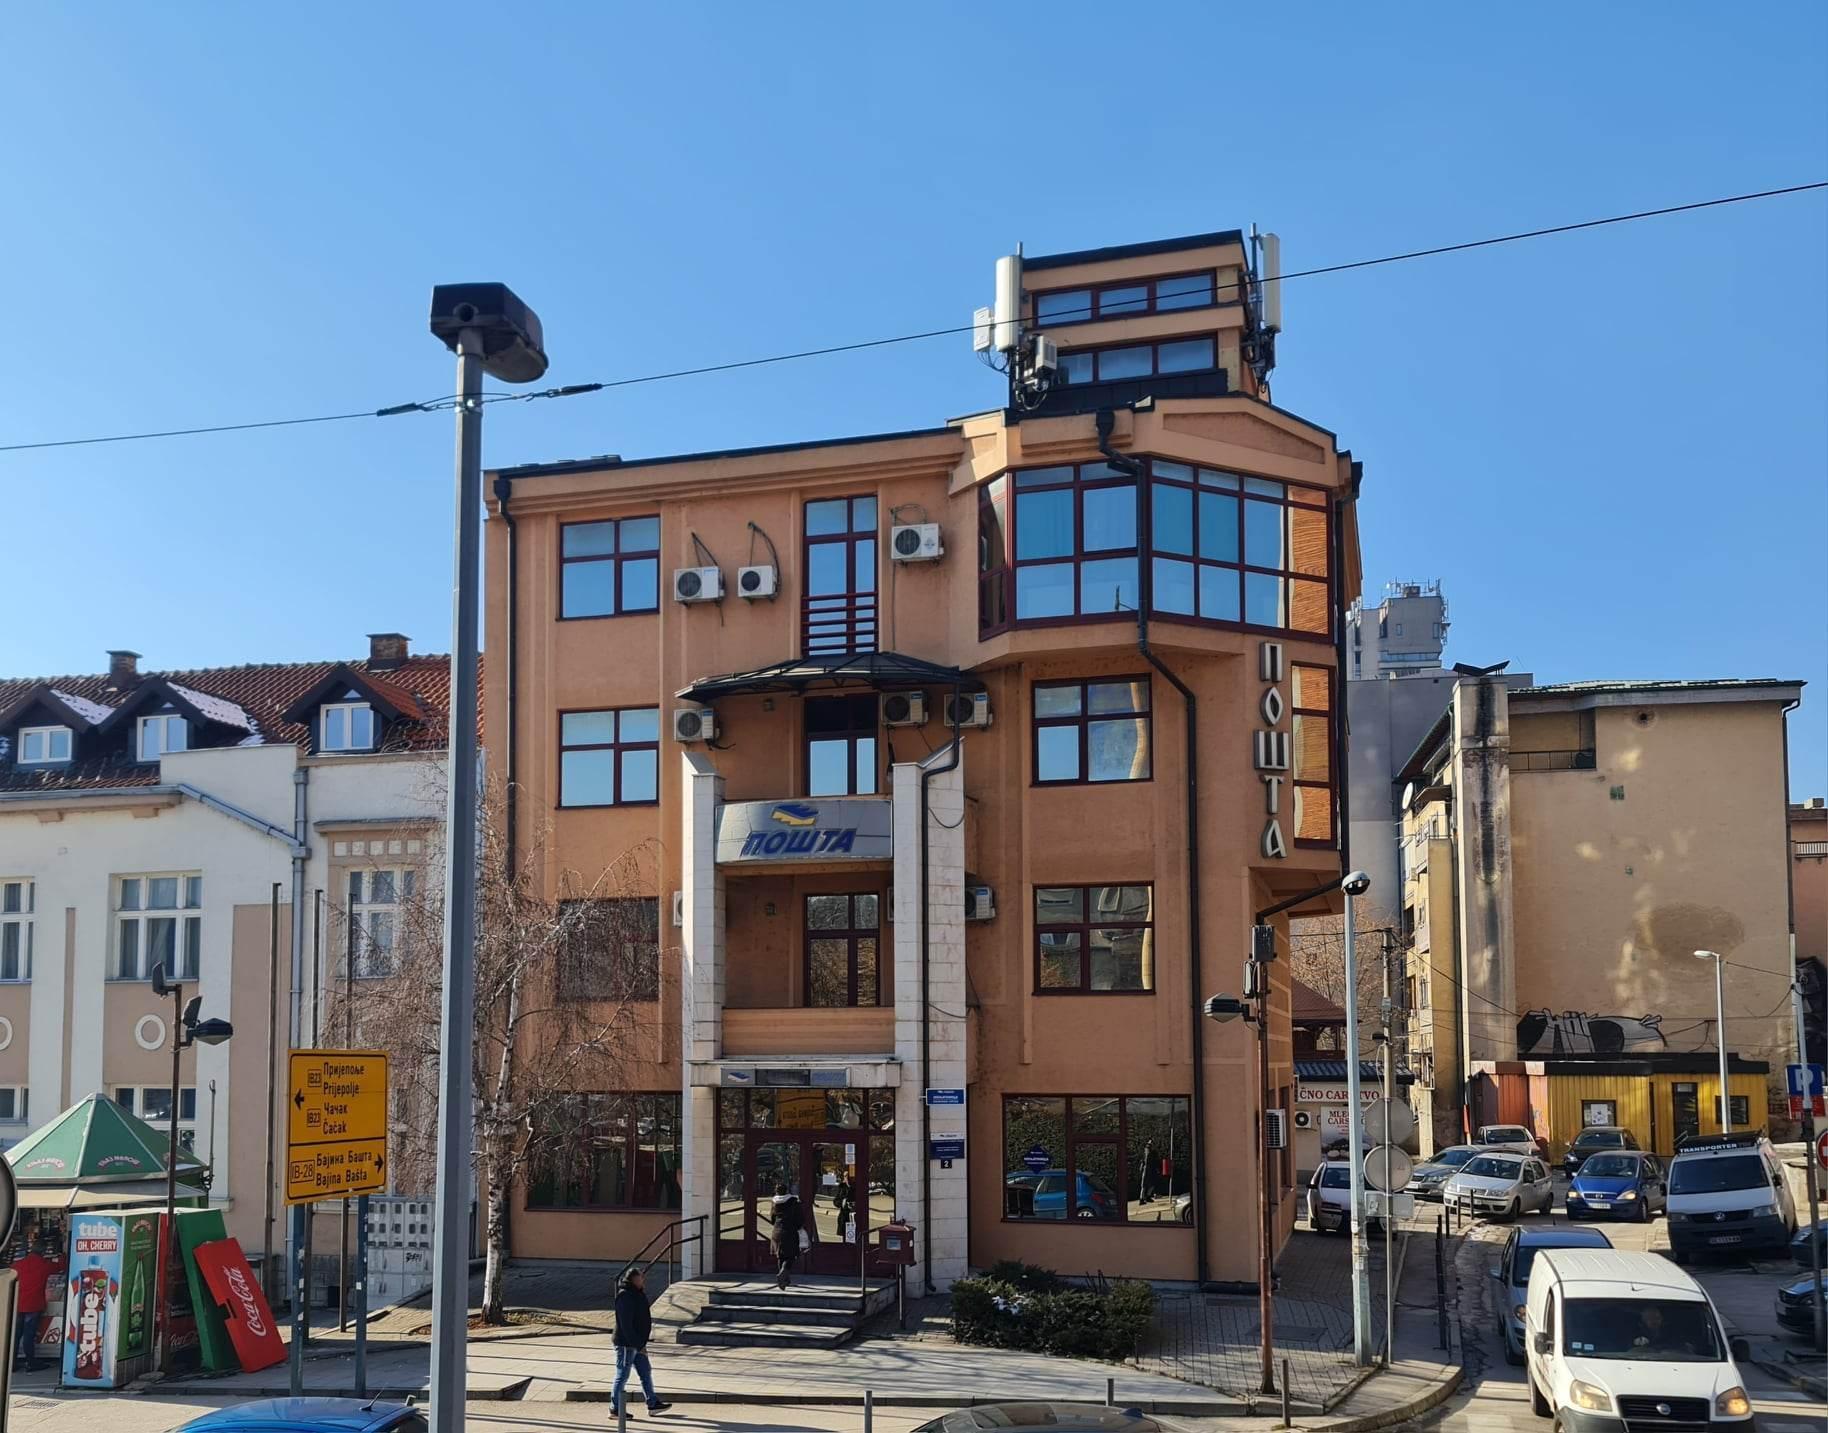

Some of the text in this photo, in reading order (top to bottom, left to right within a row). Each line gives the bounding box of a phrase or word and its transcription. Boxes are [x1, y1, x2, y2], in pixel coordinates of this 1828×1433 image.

[1254, 642, 1289, 858] ПОШТА
[740, 828, 857, 856] ПОШТА
[323, 1062, 364, 1079] Пријепоље
[1795, 1068, 1814, 1092] P
[323, 1082, 360, 1098] Prijepolje
[1326, 1090, 1380, 1100] CARTVO
[324, 1103, 348, 1116] Чачак
[323, 1118, 347, 1135] Čačak
[1680, 1143, 1738, 1153] TRANSPORTER
[317, 1150, 372, 1168] Бајина Башта
[316, 1169, 367, 1188] Bajina Bašta
[79, 1222, 118, 1237] tube
[91, 1240, 117, 1251] CHERRY
[80, 1293, 99, 1353] tube
